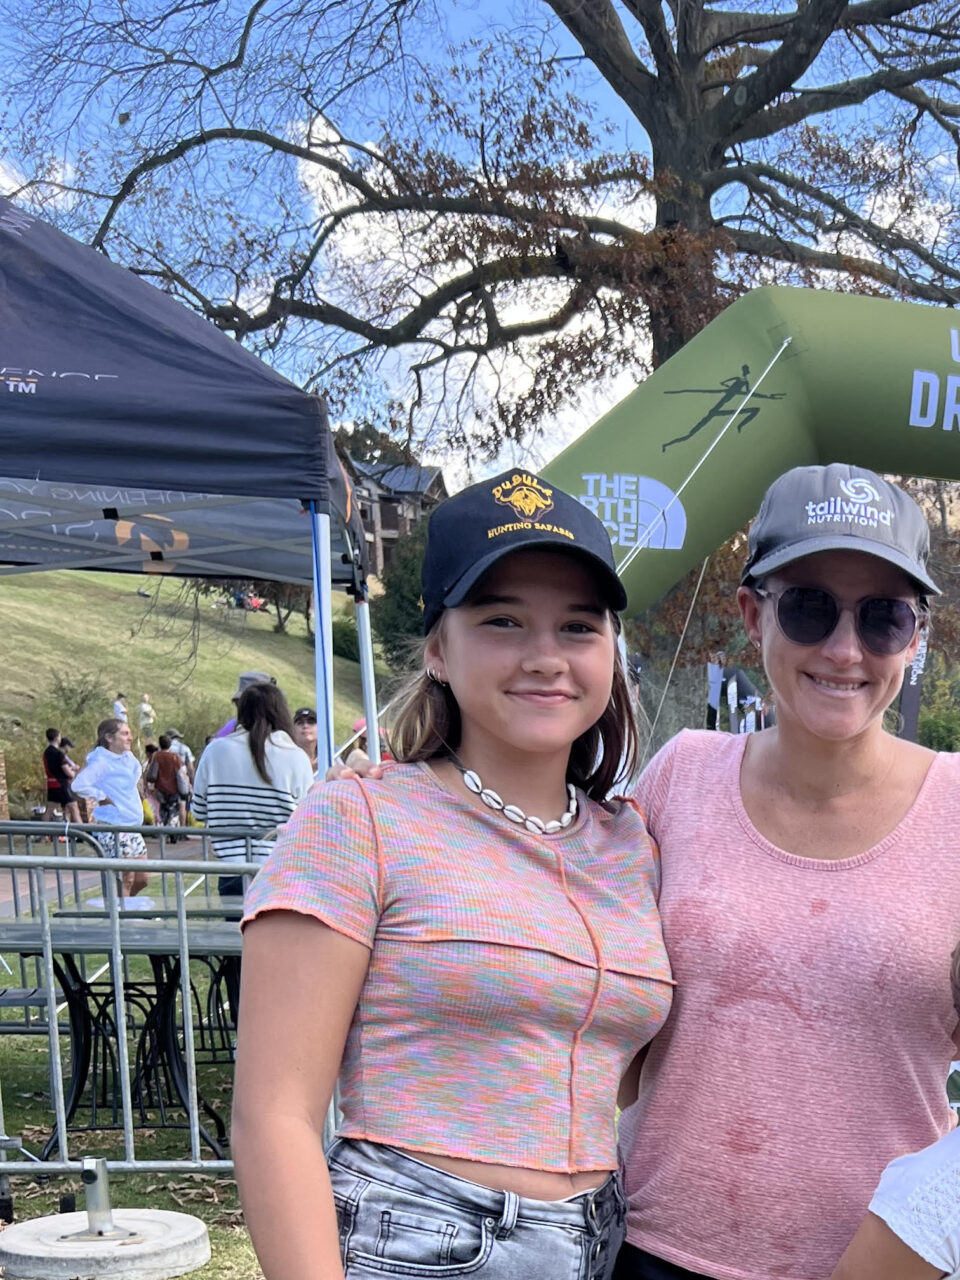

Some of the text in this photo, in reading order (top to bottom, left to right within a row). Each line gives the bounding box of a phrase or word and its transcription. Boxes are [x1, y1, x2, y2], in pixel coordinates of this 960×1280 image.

[6, 380, 36, 394] TM
[581, 473, 638, 499] THE
[569, 494, 637, 523] RTH
[805, 497, 891, 527] tailwind
[807, 513, 878, 529] NUTRITION
[487, 521, 532, 539] HUNTING
[602, 520, 637, 547] CE
